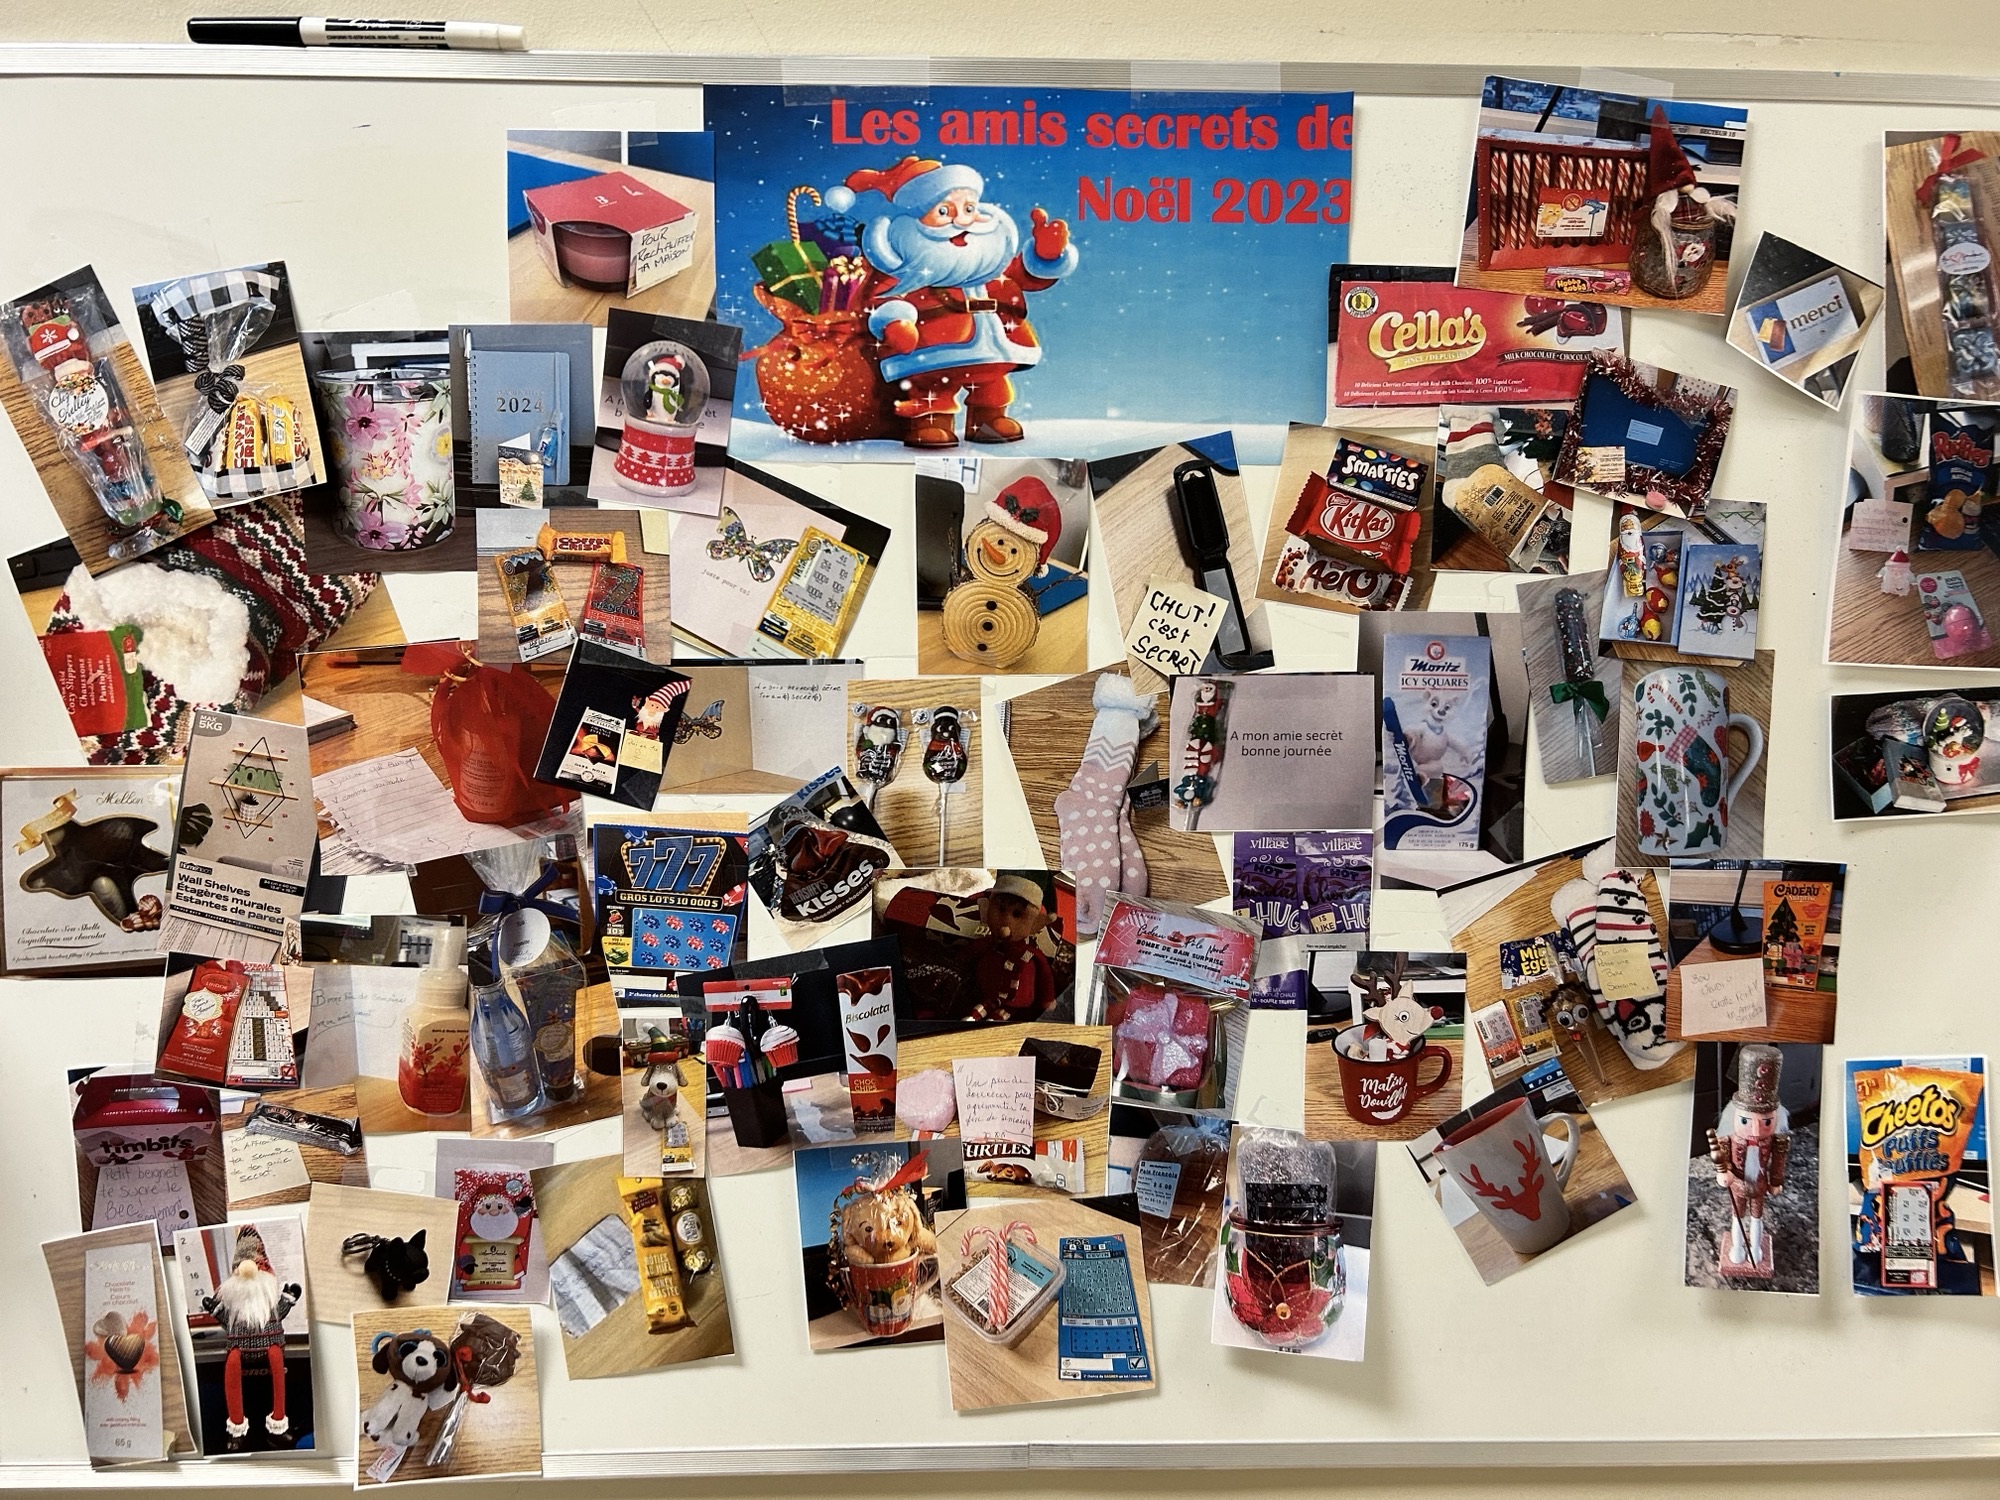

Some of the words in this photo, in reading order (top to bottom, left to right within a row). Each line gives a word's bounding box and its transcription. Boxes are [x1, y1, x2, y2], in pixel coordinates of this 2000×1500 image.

[831, 99, 919, 146] Les
[939, 101, 1067, 146] amis
[1086, 105, 1278, 151] secrets
[1298, 105, 1353, 151] de
[1078, 178, 1190, 224] Noël
[1212, 179, 1350, 224] 2023
[1790, 294, 1844, 331] merci
[1368, 307, 1487, 358] Cella's
[1504, 353, 1519, 361] MILK
[1520, 350, 1556, 359] CHOCOLATE
[497, 397, 544, 413] 2024
[1932, 431, 1992, 468] Ruffles
[1329, 502, 1389, 540] KitKat
[702, 568, 721, 580] juste
[721, 578, 738, 590] pour
[1150, 590, 1216, 627] CHUT!
[66, 654, 76, 690] Slippers
[1410, 658, 1461, 672] Moritz
[79, 659, 88, 707] Chaussons
[1401, 677, 1420, 687] ICY
[1422, 677, 1469, 688] SQUARES
[198, 721, 223, 732] 5KG
[201, 715, 218, 723] MAX
[1230, 731, 1239, 741] A
[1242, 732, 1269, 741] mon
[1273, 731, 1302, 741] amie
[1306, 730, 1343, 741] secrèt
[1241, 745, 1280, 756] bonne
[1283, 745, 1332, 759] journée
[1394, 740, 1415, 782] Moritz
[1251, 837, 1289, 850] village
[1322, 837, 1362, 851] village
[629, 835, 721, 890] 777
[1254, 865, 1283, 878] HOT
[1330, 868, 1359, 880] HOT
[178, 873, 202, 886] Wall
[204, 879, 251, 897] Shelves
[789, 880, 829, 904] HERSHEY'S
[1774, 883, 1821, 898] CADEAU
[177, 881, 229, 902] Étagères
[231, 897, 282, 914] murales
[619, 893, 647, 902] GROS
[649, 895, 674, 904] LOTS
[677, 896, 689, 905] 10
[691, 898, 710, 906] 000
[711, 899, 719, 908] $
[176, 892, 228, 912] Estantes
[230, 906, 246, 916] de
[247, 911, 284, 925] pared
[1339, 902, 1370, 930] HU
[22, 926, 60, 936] Chocolate
[76, 922, 100, 932] Shells
[1316, 922, 1335, 933] LIKE
[74, 932, 107, 941] chocolat
[1136, 939, 1160, 949] BOMBE
[1173, 947, 1190, 957] BAIN
[1192, 952, 1224, 966] SURPRISE
[1207, 944, 1229, 955] Nord
[1519, 945, 1547, 962] Min
[1520, 958, 1549, 976] Egg
[205, 981, 228, 990] LINDOR
[845, 1003, 890, 1024] Biscolata
[1360, 1073, 1404, 1095] Matin
[1015, 1091, 1034, 1103] pour
[986, 1113, 997, 1121] de
[1862, 1084, 1959, 1147] Cheetos
[100, 1135, 193, 1154] timbits
[104, 1166, 132, 1180] Petit
[138, 1165, 179, 1178] beignet
[101, 1185, 114, 1198] te
[168, 1182, 182, 1193] le
[194, 1288, 205, 1296] 23
[114, 1439, 125, 1448] 65
[127, 1440, 132, 1449] g
